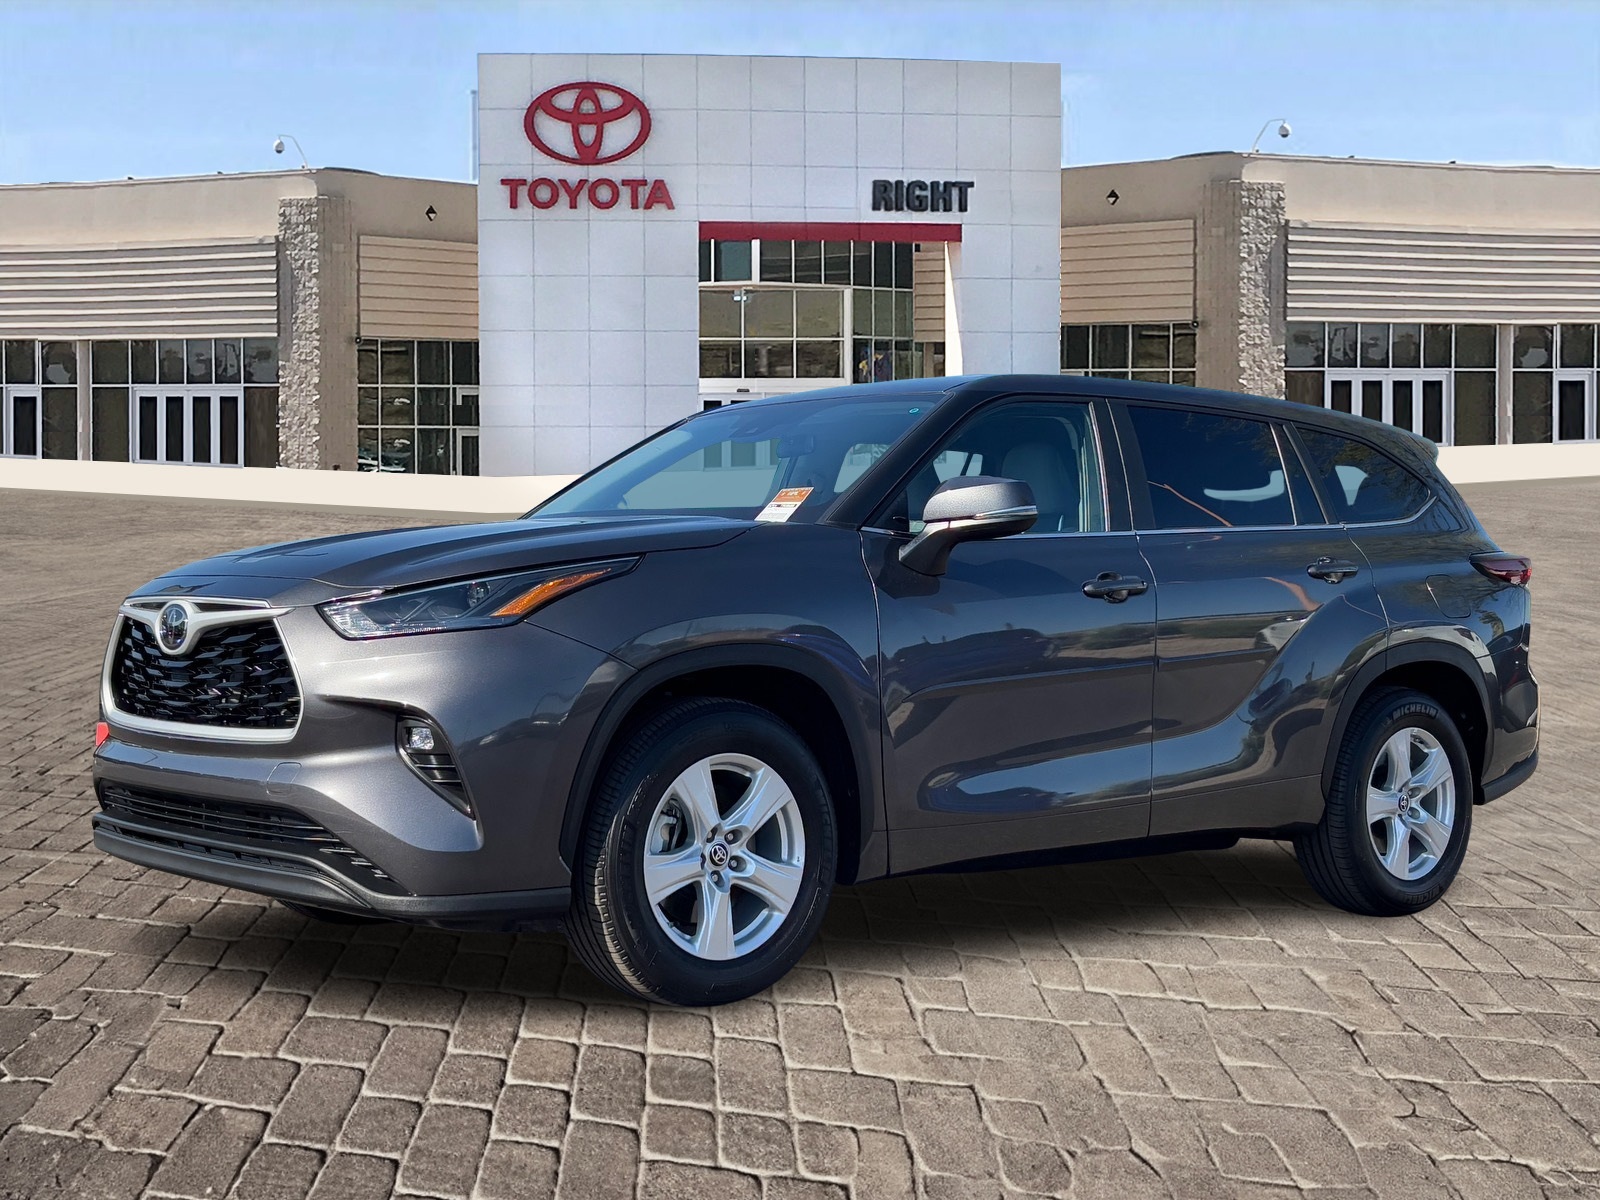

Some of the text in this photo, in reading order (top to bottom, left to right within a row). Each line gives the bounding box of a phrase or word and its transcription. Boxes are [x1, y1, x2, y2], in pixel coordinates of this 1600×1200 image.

[500, 177, 675, 210] TOYOTA
[872, 179, 975, 212] RIGHT
[1392, 703, 1437, 720] MICHELIN
